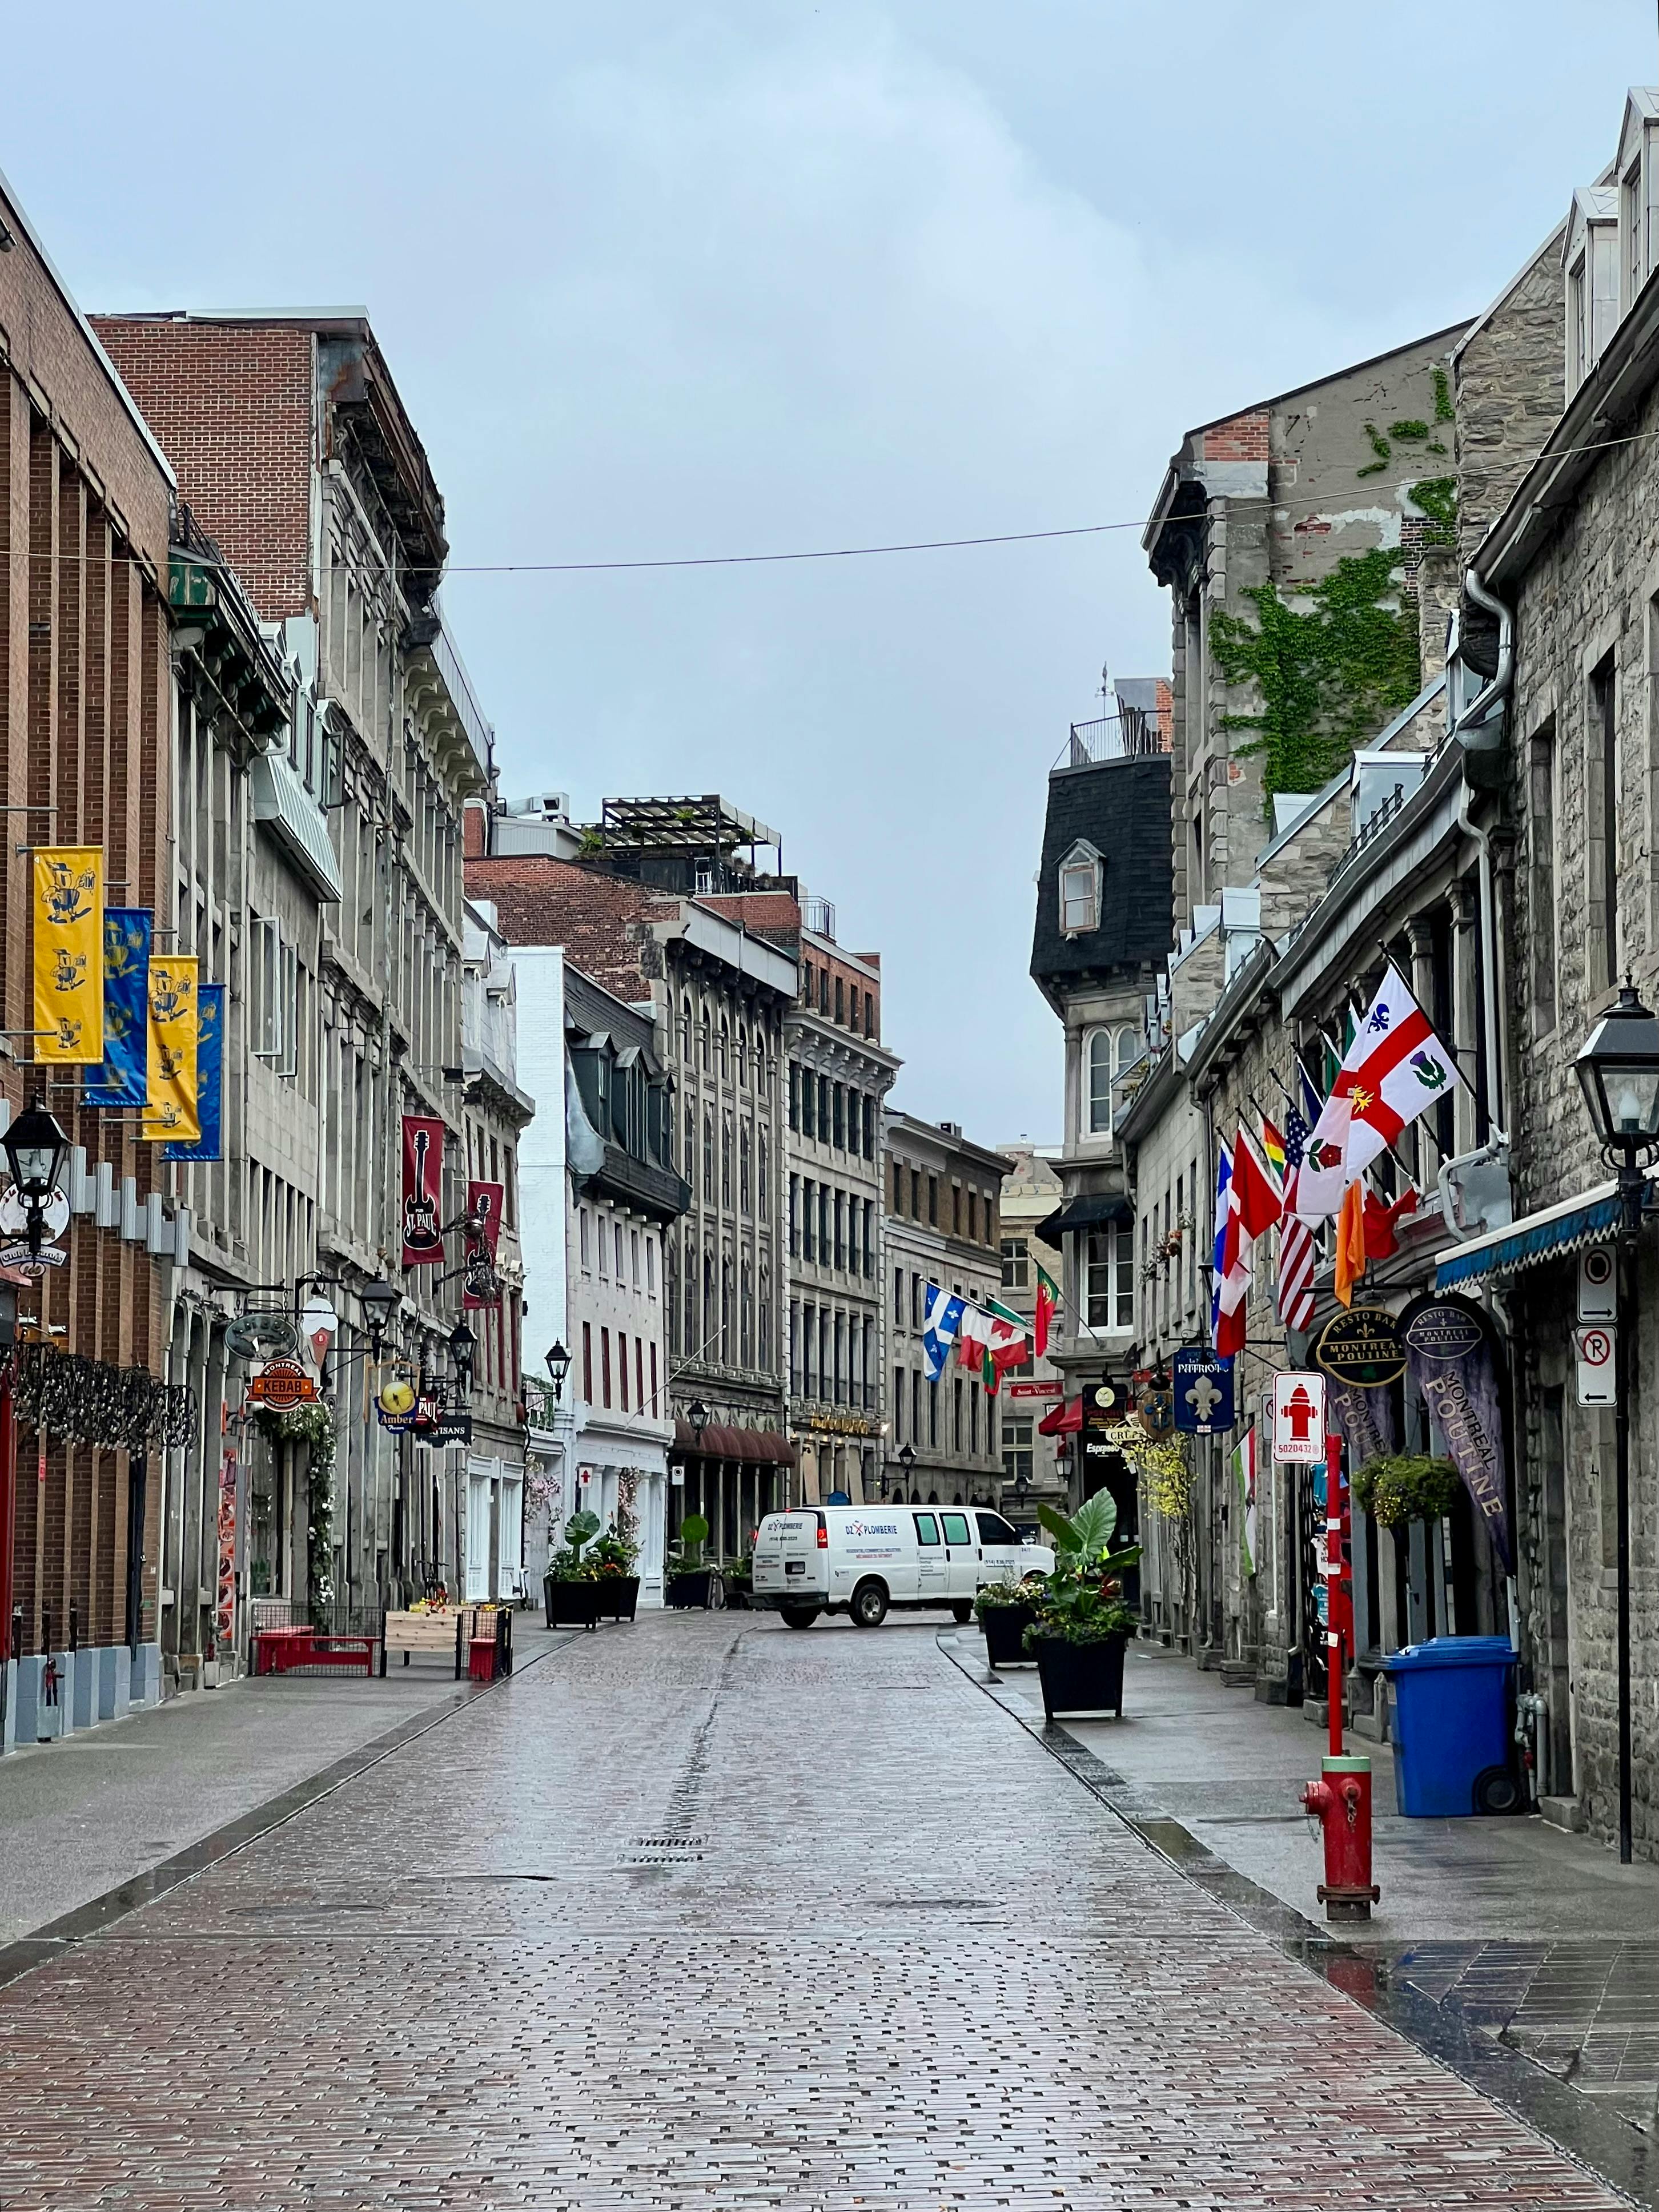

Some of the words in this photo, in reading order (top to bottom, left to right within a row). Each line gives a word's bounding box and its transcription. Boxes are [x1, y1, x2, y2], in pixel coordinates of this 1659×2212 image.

[417, 1214, 436, 1237] PAUL
[1333, 1312, 1370, 1334] RESTO
[1417, 1310, 1444, 1325] RESTO
[1450, 1311, 1467, 1322] BAR
[1337, 1350, 1399, 1361] POUTINE
[264, 1362, 302, 1377] MONTREAL
[263, 1380, 302, 1393] KEBAB
[380, 1414, 413, 1424] Amber
[419, 1402, 437, 1423] PAUL
[1443, 1371, 1496, 1470] MONTREAL
[1086, 1443, 1119, 1454] Espresso
[1279, 1445, 1312, 1453] 5020432
[1425, 1377, 1504, 1517] POUTINE
[845, 1526, 854, 1535] DZ
[865, 1525, 898, 1535] PLOMBERIE
